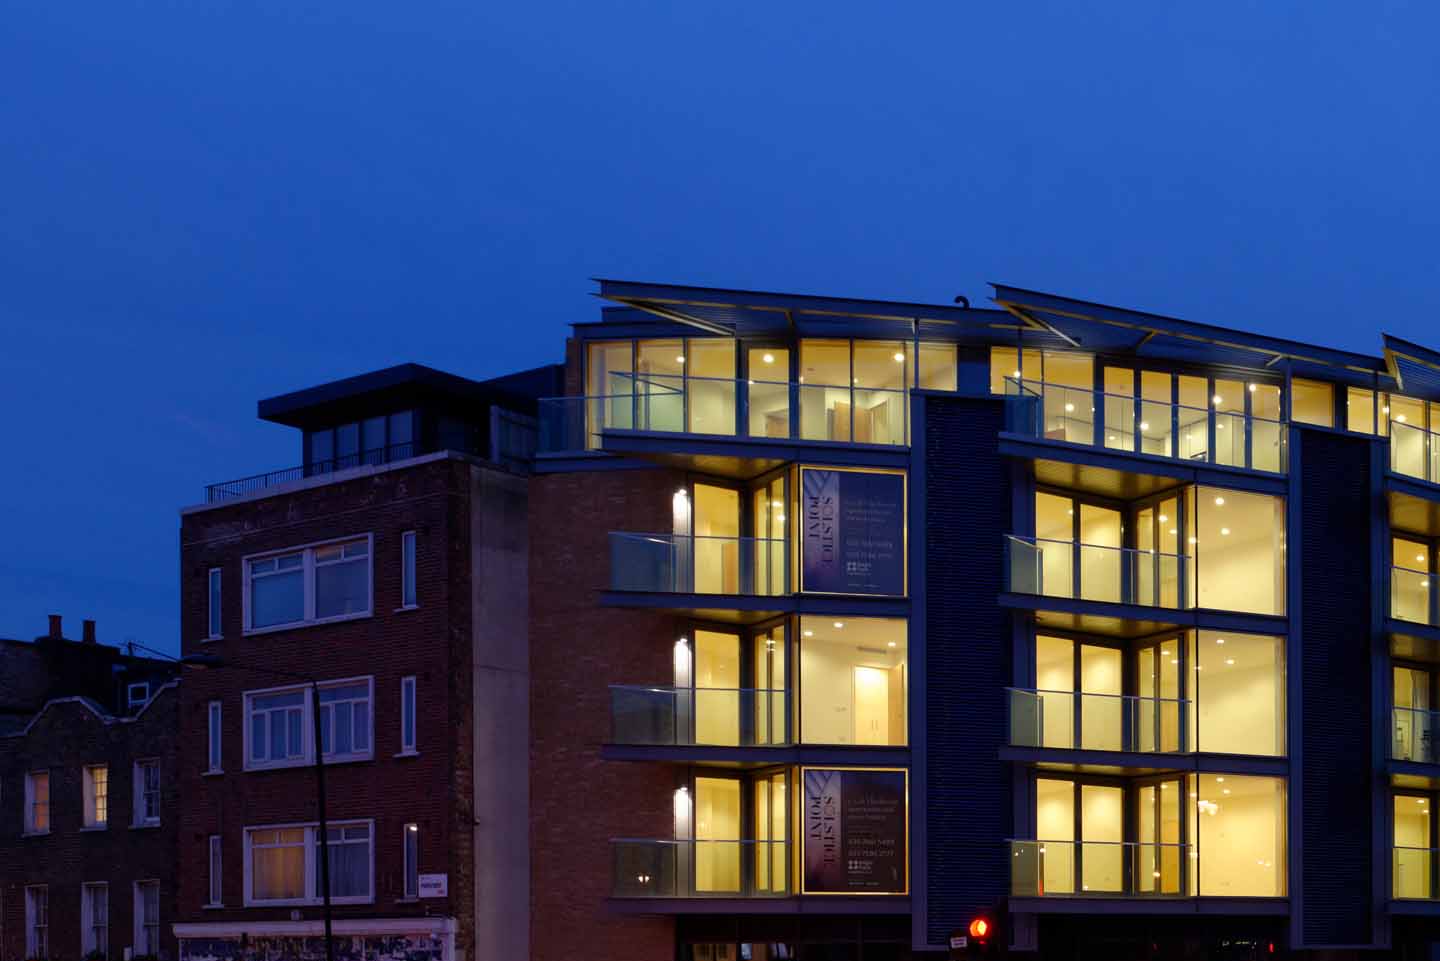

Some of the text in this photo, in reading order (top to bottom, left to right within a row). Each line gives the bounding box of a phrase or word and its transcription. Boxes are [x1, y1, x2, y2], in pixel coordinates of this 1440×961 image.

[808, 495, 820, 542] POINT
[810, 796, 822, 841] POINT
[823, 796, 835, 867] SOLSTICE
